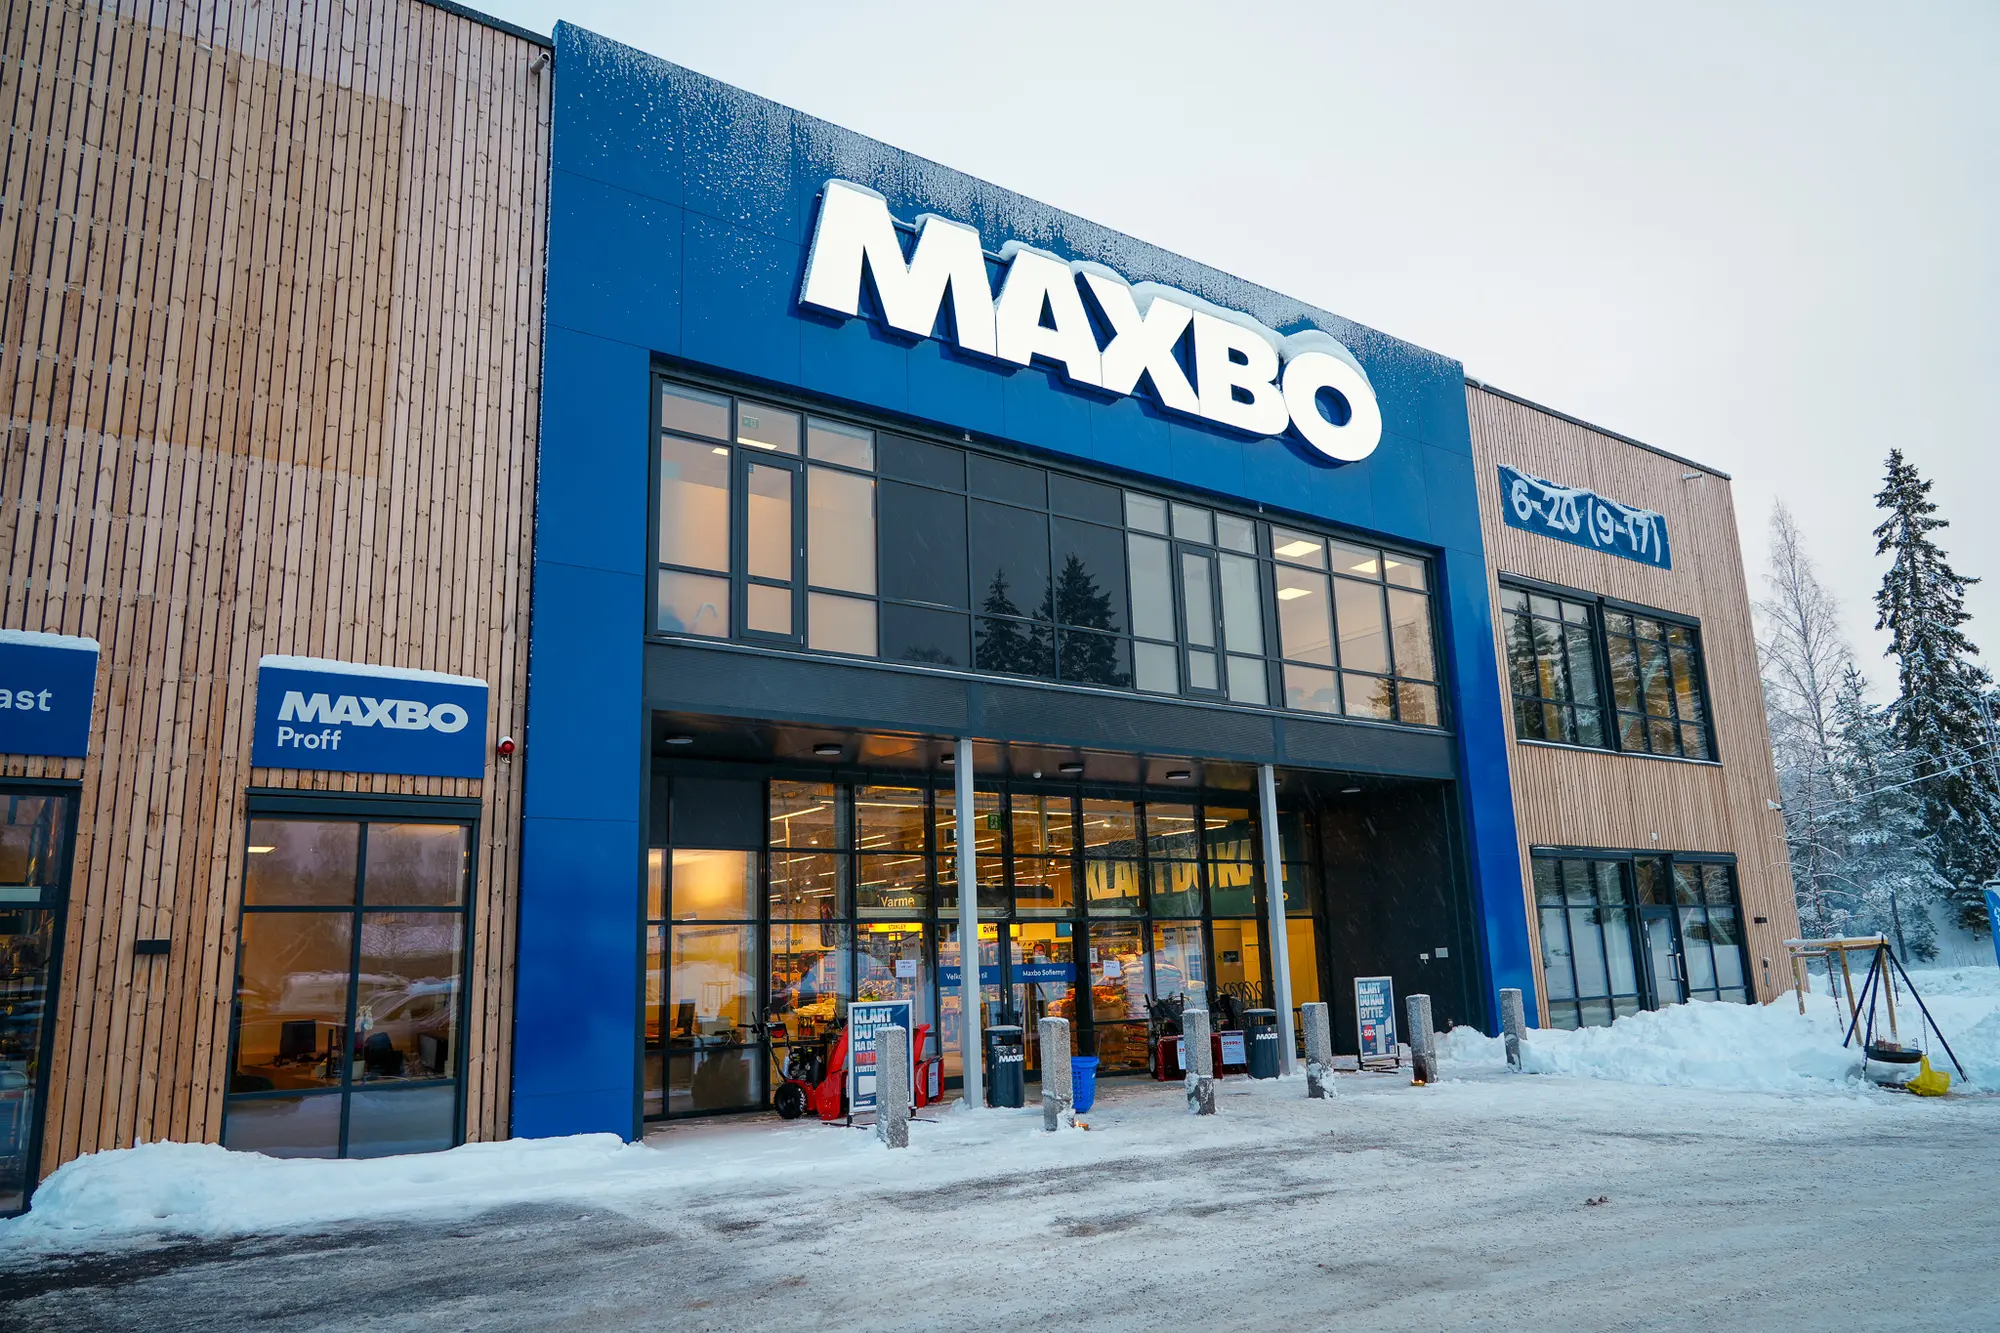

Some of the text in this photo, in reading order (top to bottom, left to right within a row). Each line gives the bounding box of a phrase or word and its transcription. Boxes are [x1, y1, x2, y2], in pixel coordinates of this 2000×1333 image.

[800, 180, 1383, 463] MAXBO
[1511, 479, 1661, 563] 6-20 (9-17)
[277, 691, 469, 733] MAXBO
[277, 726, 342, 750] Proff
[881, 896, 915, 907] Varme
[1359, 982, 1380, 994] KLART
[1360, 995, 1370, 1007] DU
[854, 1008, 892, 1024] KLART
[1361, 1007, 1383, 1018] BYTTE
[854, 1024, 871, 1040] DU
